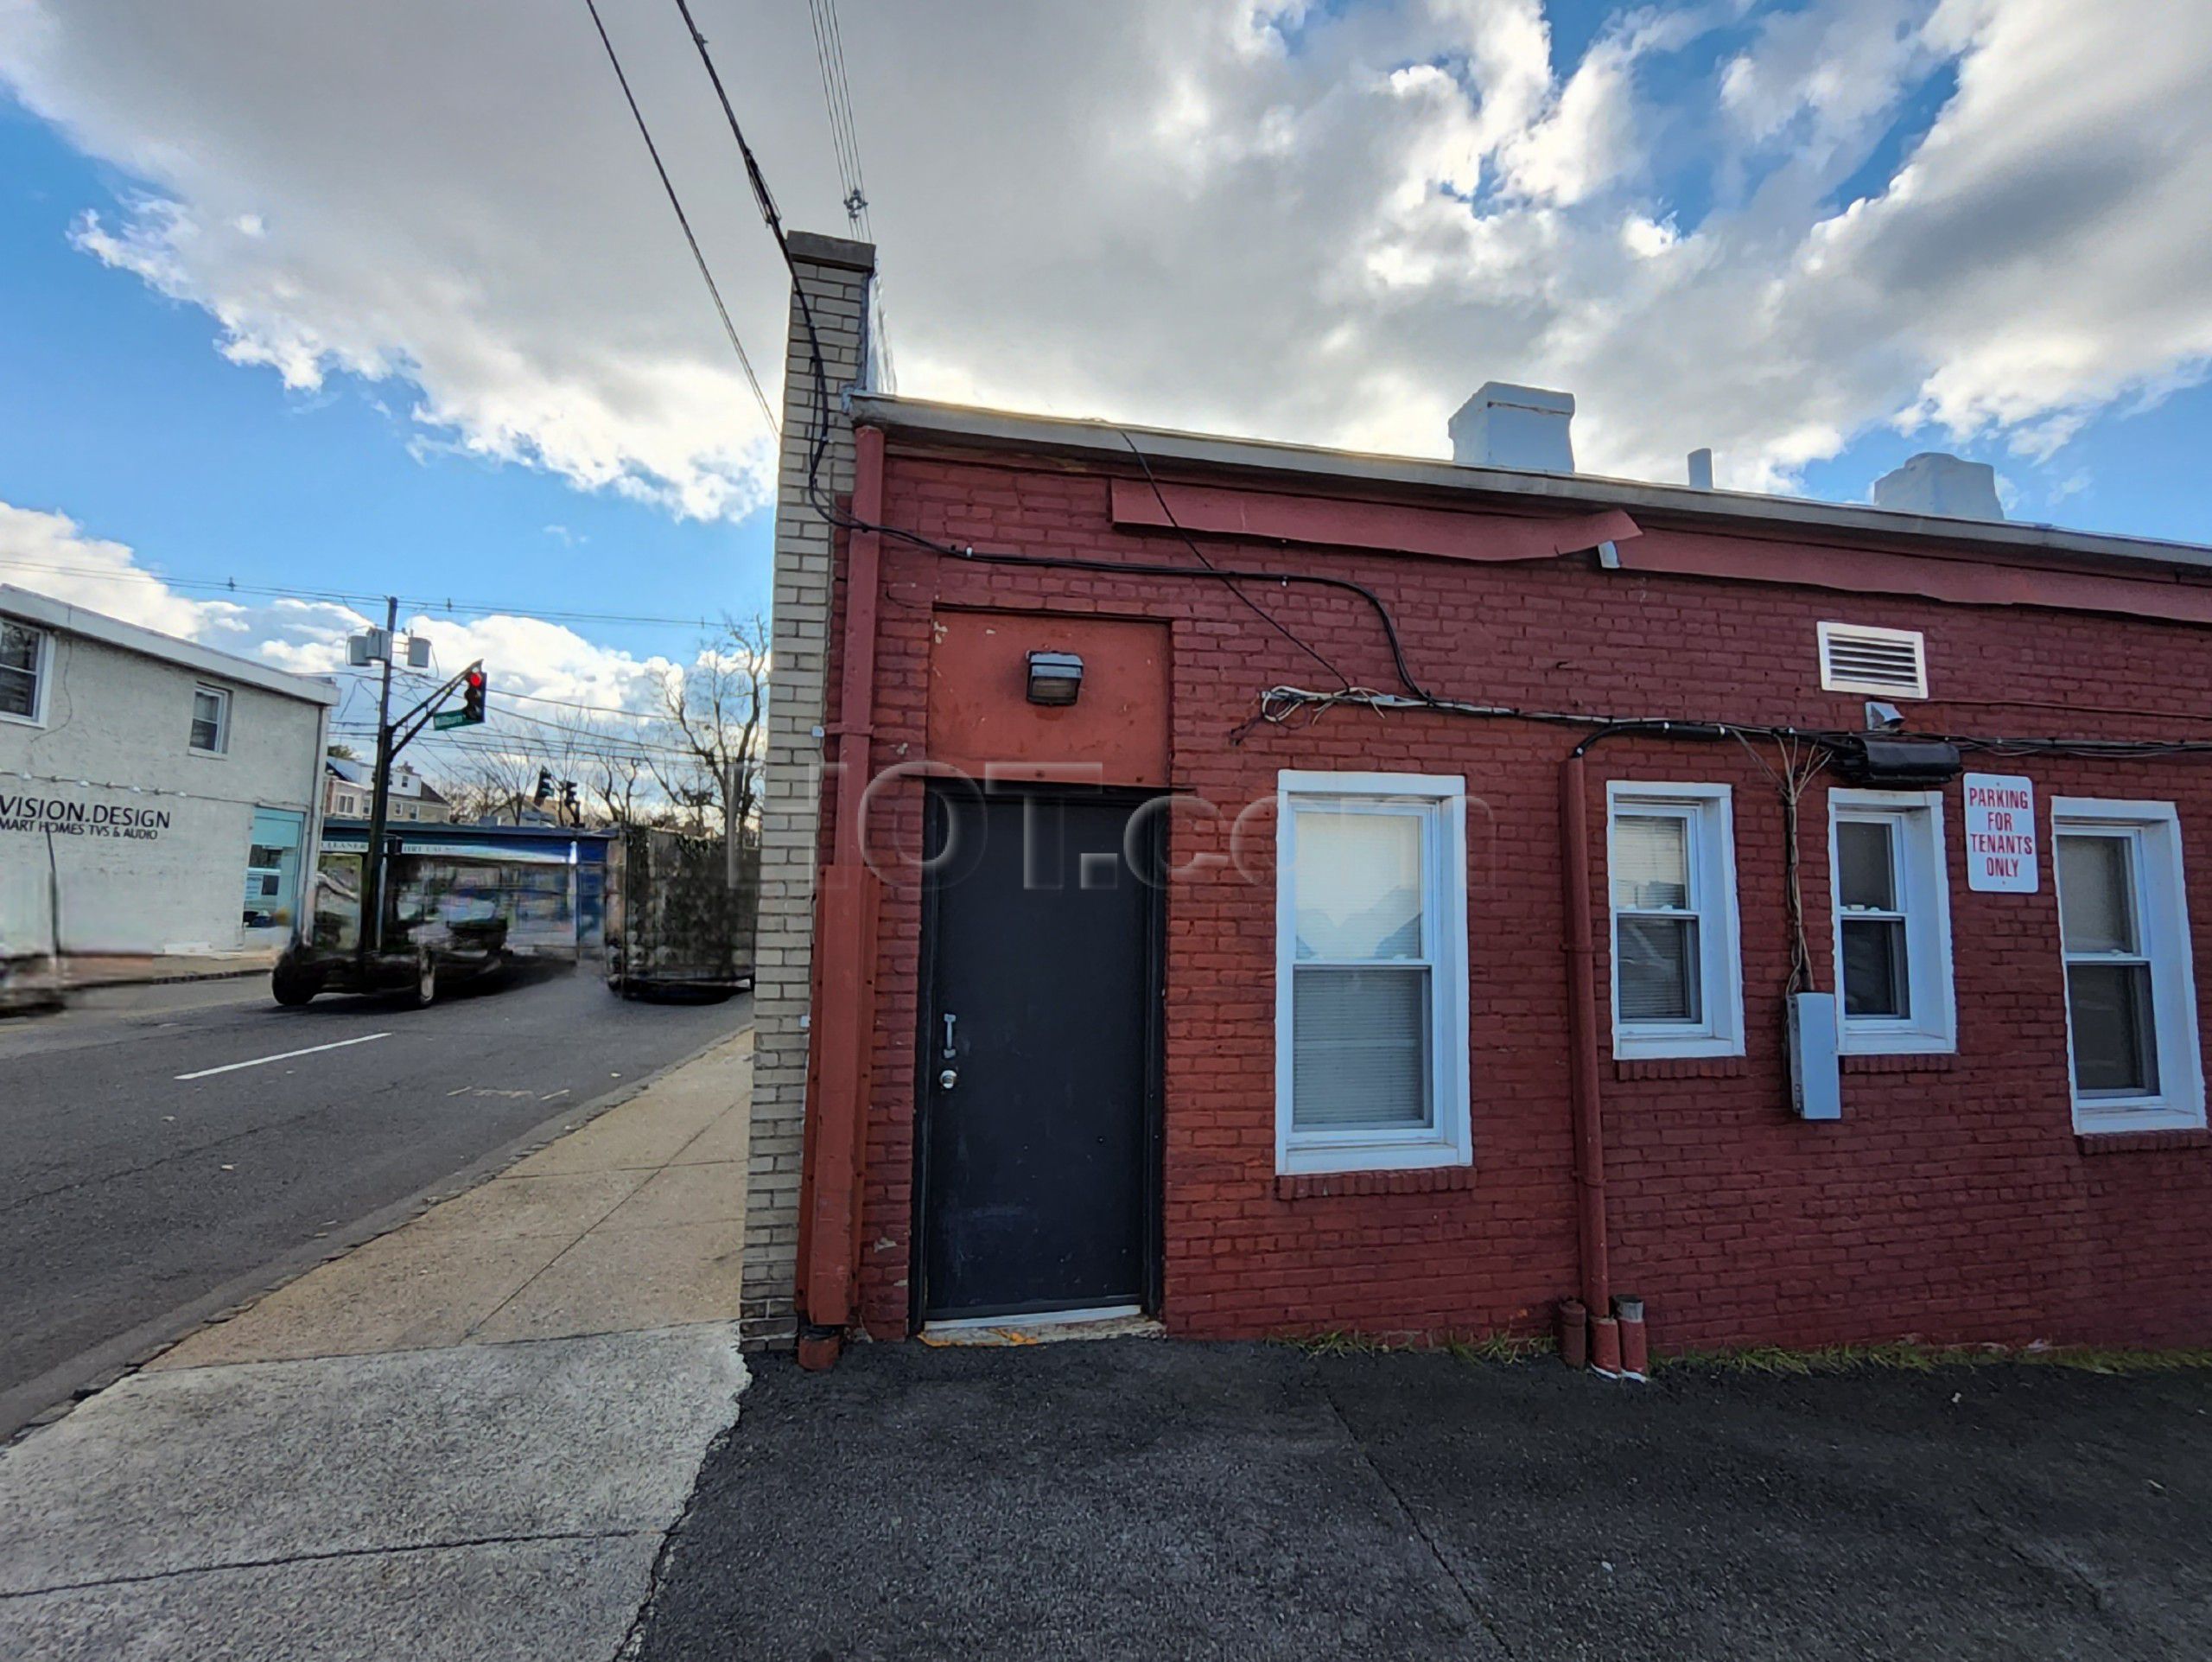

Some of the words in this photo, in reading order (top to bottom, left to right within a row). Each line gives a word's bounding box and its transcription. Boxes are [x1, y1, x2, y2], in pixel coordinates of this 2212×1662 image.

[1969, 787, 2028, 809] PARKING
[38, 822, 85, 835] HOMES
[112, 826, 120, 837] &
[123, 828, 158, 840] AUDIO
[1987, 812, 2012, 831] FOR
[1970, 834, 2032, 855] TENANTS
[1986, 857, 2019, 877] ONLY
